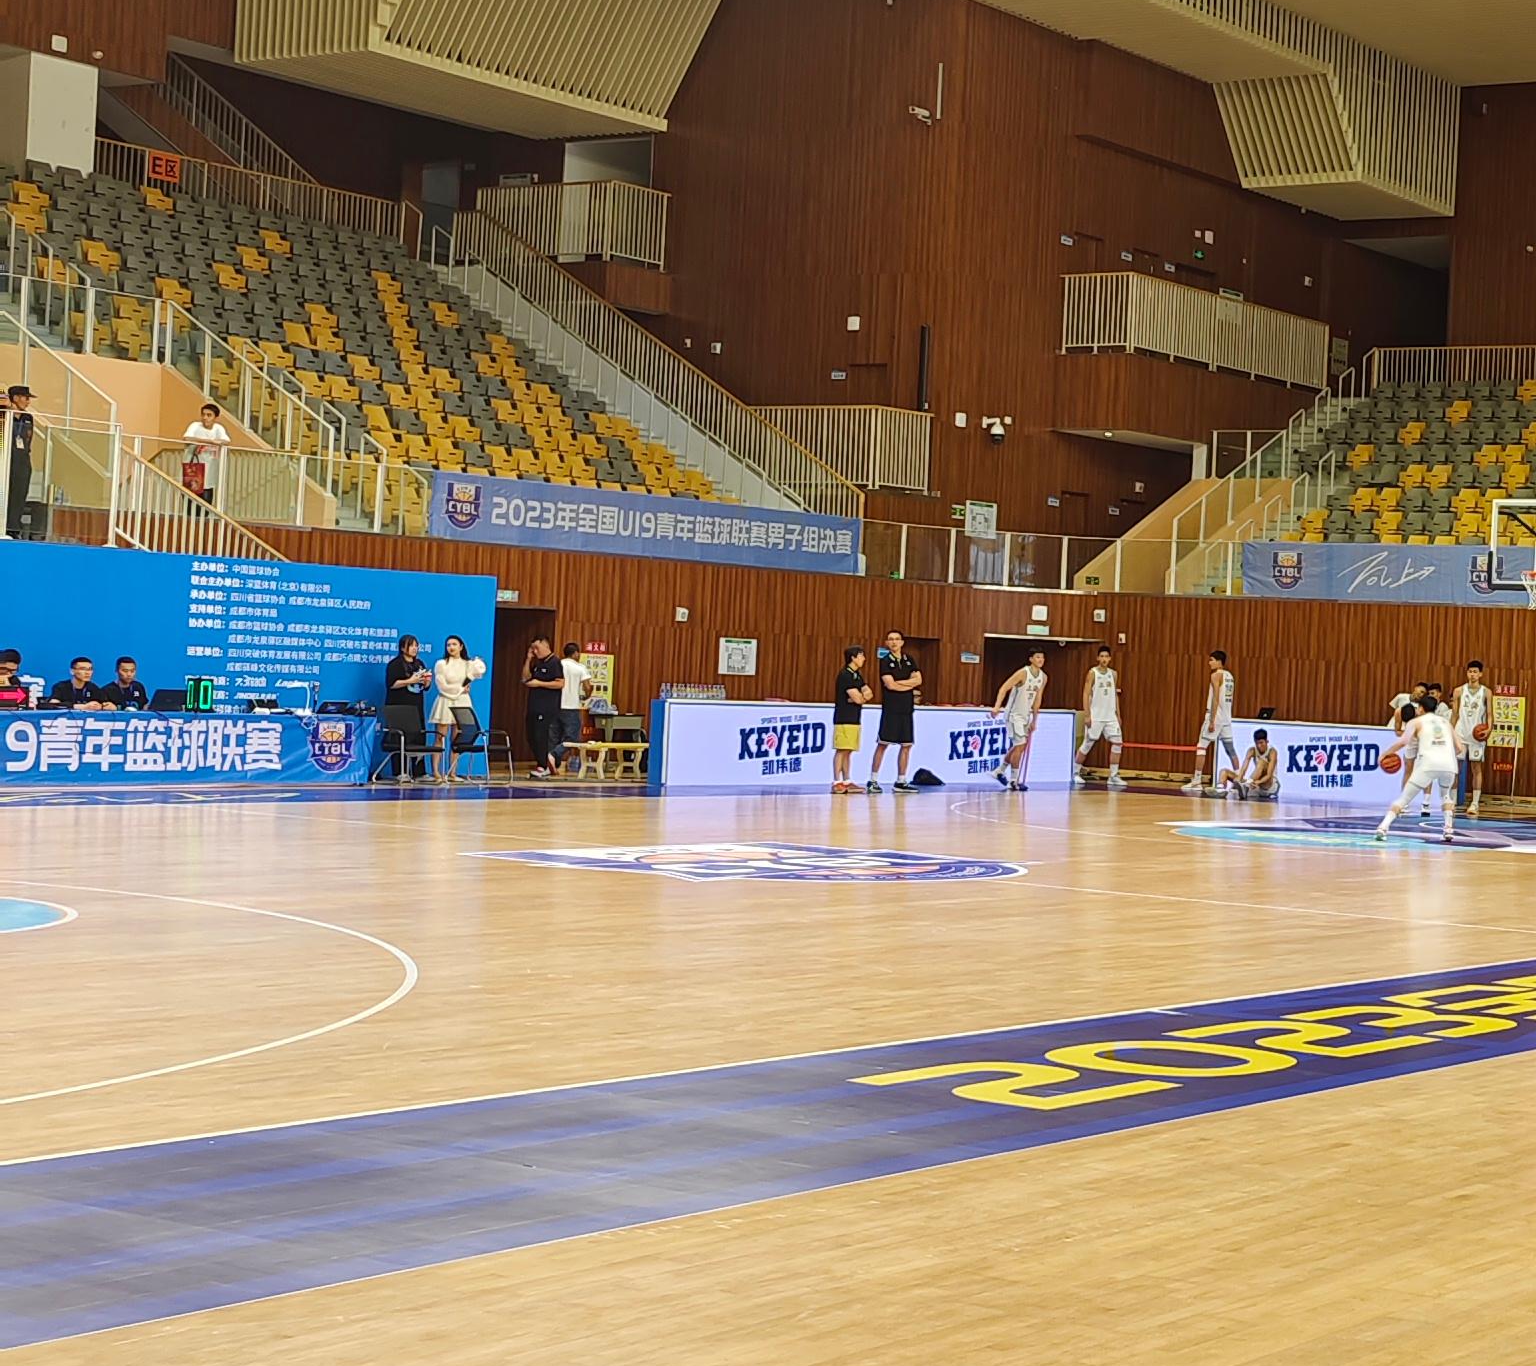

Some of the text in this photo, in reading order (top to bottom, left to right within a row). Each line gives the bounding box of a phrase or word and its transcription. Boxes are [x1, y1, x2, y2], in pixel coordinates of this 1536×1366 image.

[151, 156, 178, 179] E区
[447, 499, 478, 516] CYBL
[490, 496, 853, 555] 2023年全国U19青年篮球联赛男子组决赛
[1275, 567, 1300, 578] CYBL
[5, 717, 283, 772] 9青年篮球联赛
[314, 742, 349, 755] CYBL
[948, 727, 1013, 760] KEVEI
